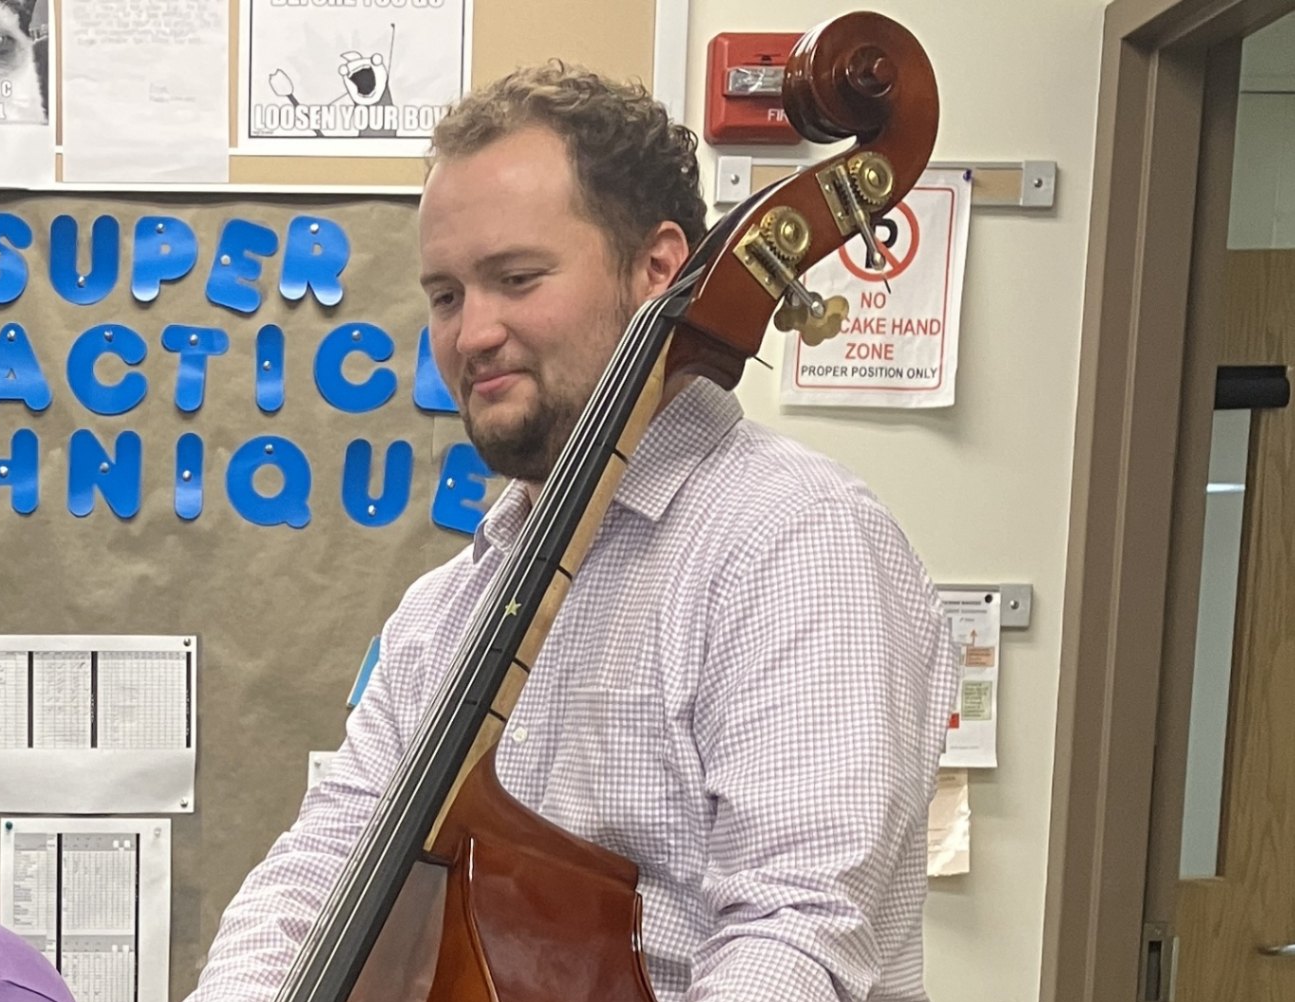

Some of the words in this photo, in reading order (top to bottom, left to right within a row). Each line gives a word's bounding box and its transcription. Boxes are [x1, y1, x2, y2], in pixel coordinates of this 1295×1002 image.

[1, 80, 12, 97] C
[253, 104, 336, 131] LOOSEN
[340, 104, 399, 131] YOUR
[860, 292, 886, 309] NO
[840, 318, 886, 335] CAKE
[891, 318, 941, 336] HAND
[845, 343, 895, 360] ZONE
[801, 365, 848, 378] PROPER
[851, 365, 904, 379] POSITION
[907, 367, 938, 379] ONLY
